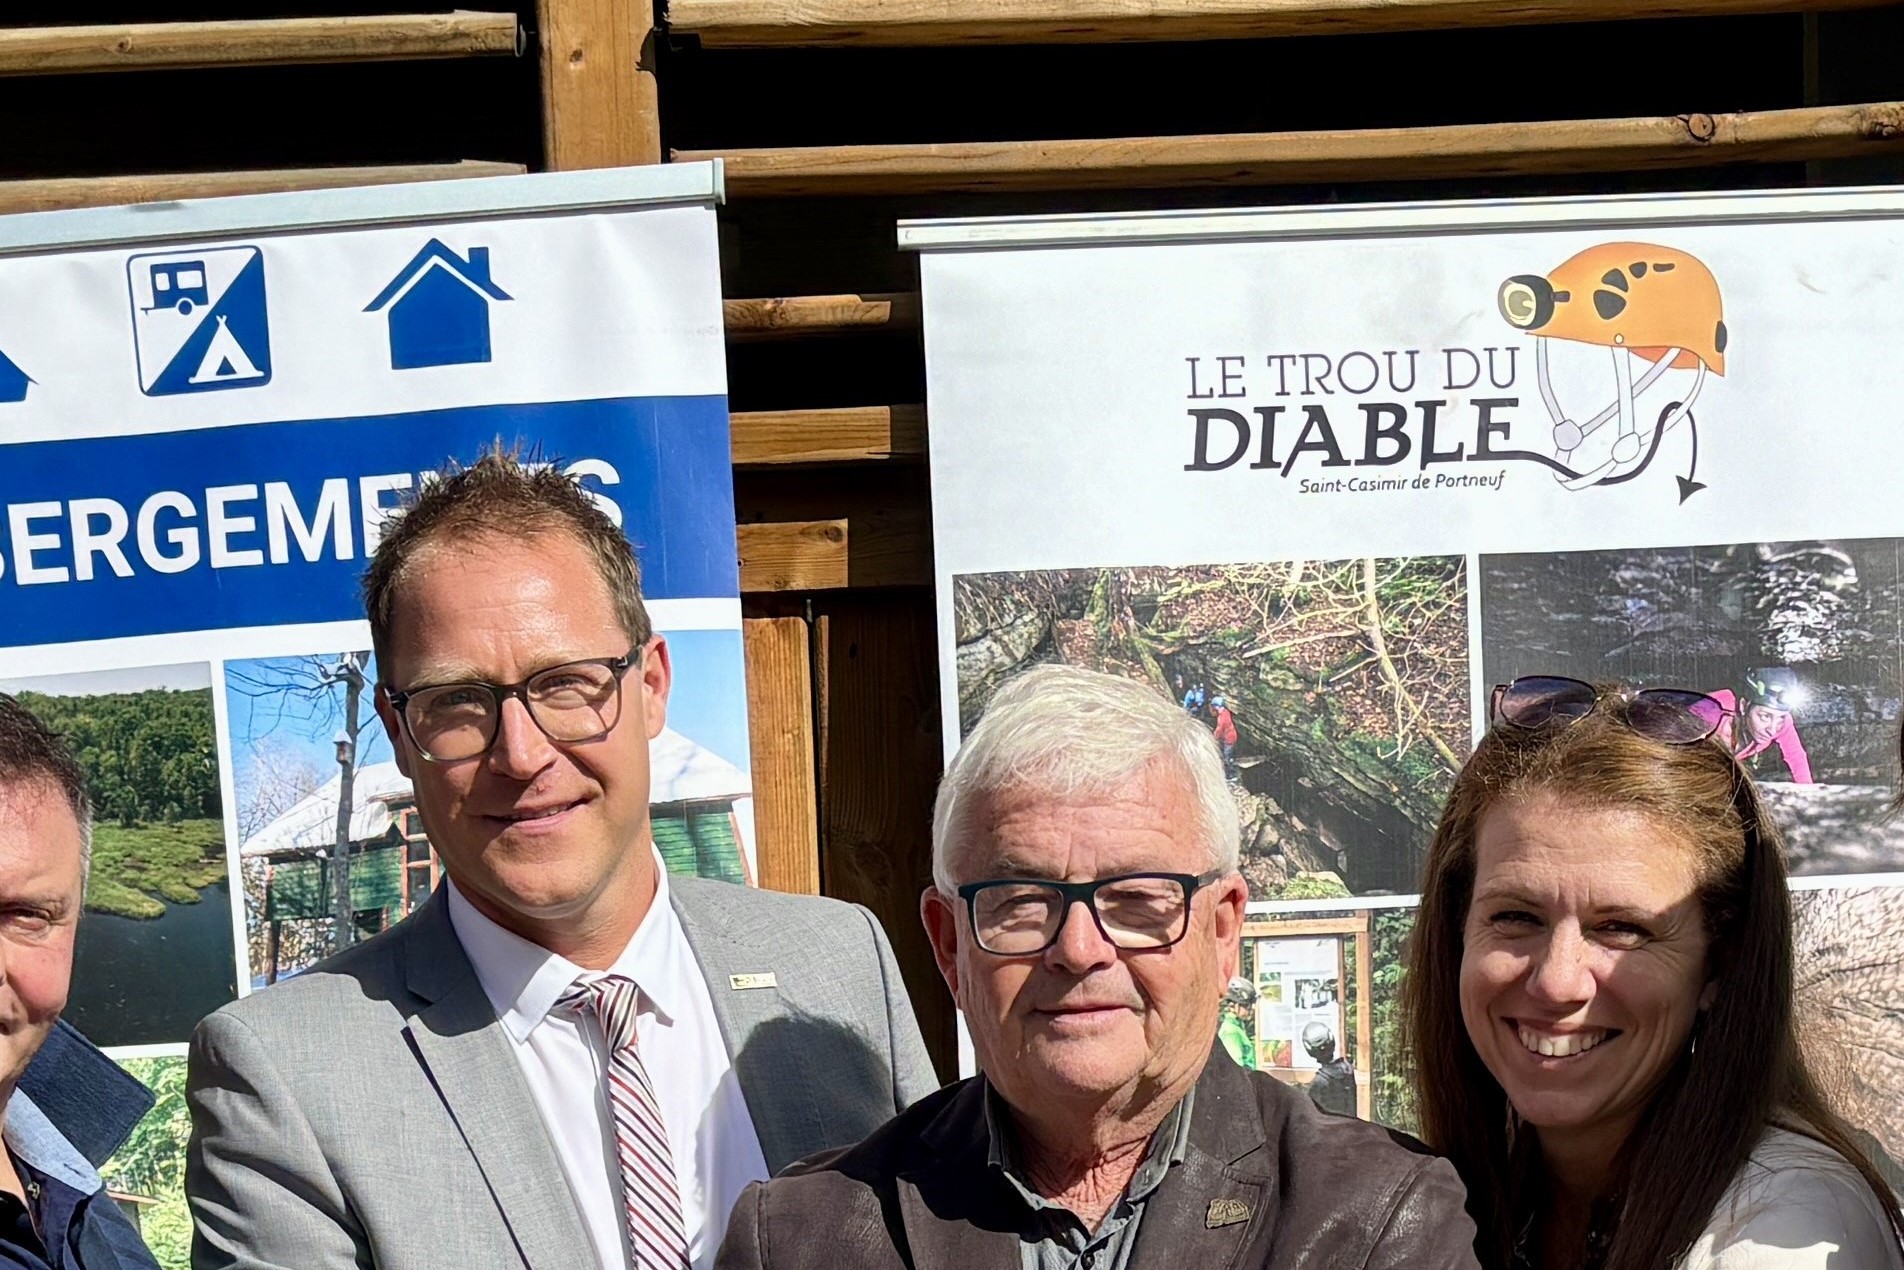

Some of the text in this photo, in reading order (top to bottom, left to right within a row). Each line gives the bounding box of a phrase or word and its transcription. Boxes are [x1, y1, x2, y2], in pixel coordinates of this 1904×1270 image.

[1186, 347, 1520, 398] LE TROU DU
[1184, 398, 1520, 478] DIABLE
[1299, 469, 1506, 493] Saint-Casimir de Portneuf
